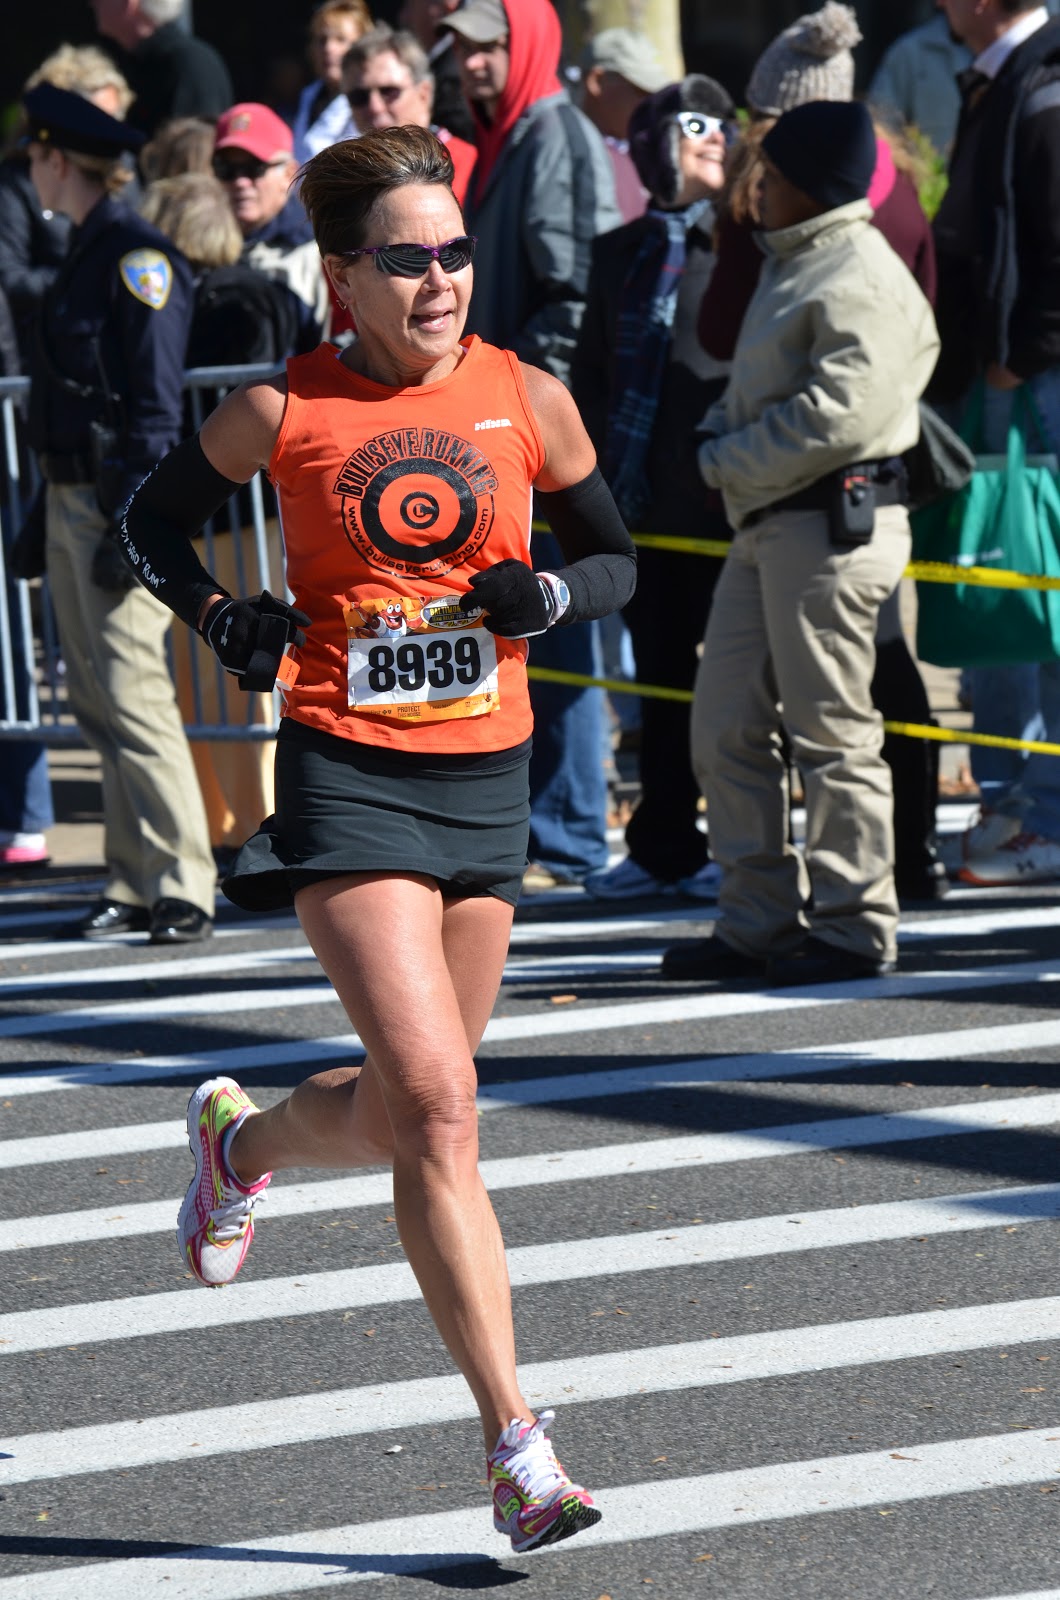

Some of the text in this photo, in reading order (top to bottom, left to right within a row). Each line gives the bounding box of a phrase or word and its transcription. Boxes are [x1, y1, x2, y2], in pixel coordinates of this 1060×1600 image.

[332, 427, 499, 500] BULLSEYE RUNNING
[349, 506, 489, 573] www.bullseyerunning.com
[368, 637, 481, 692] 8939
[397, 705, 420, 713] PROTECT
